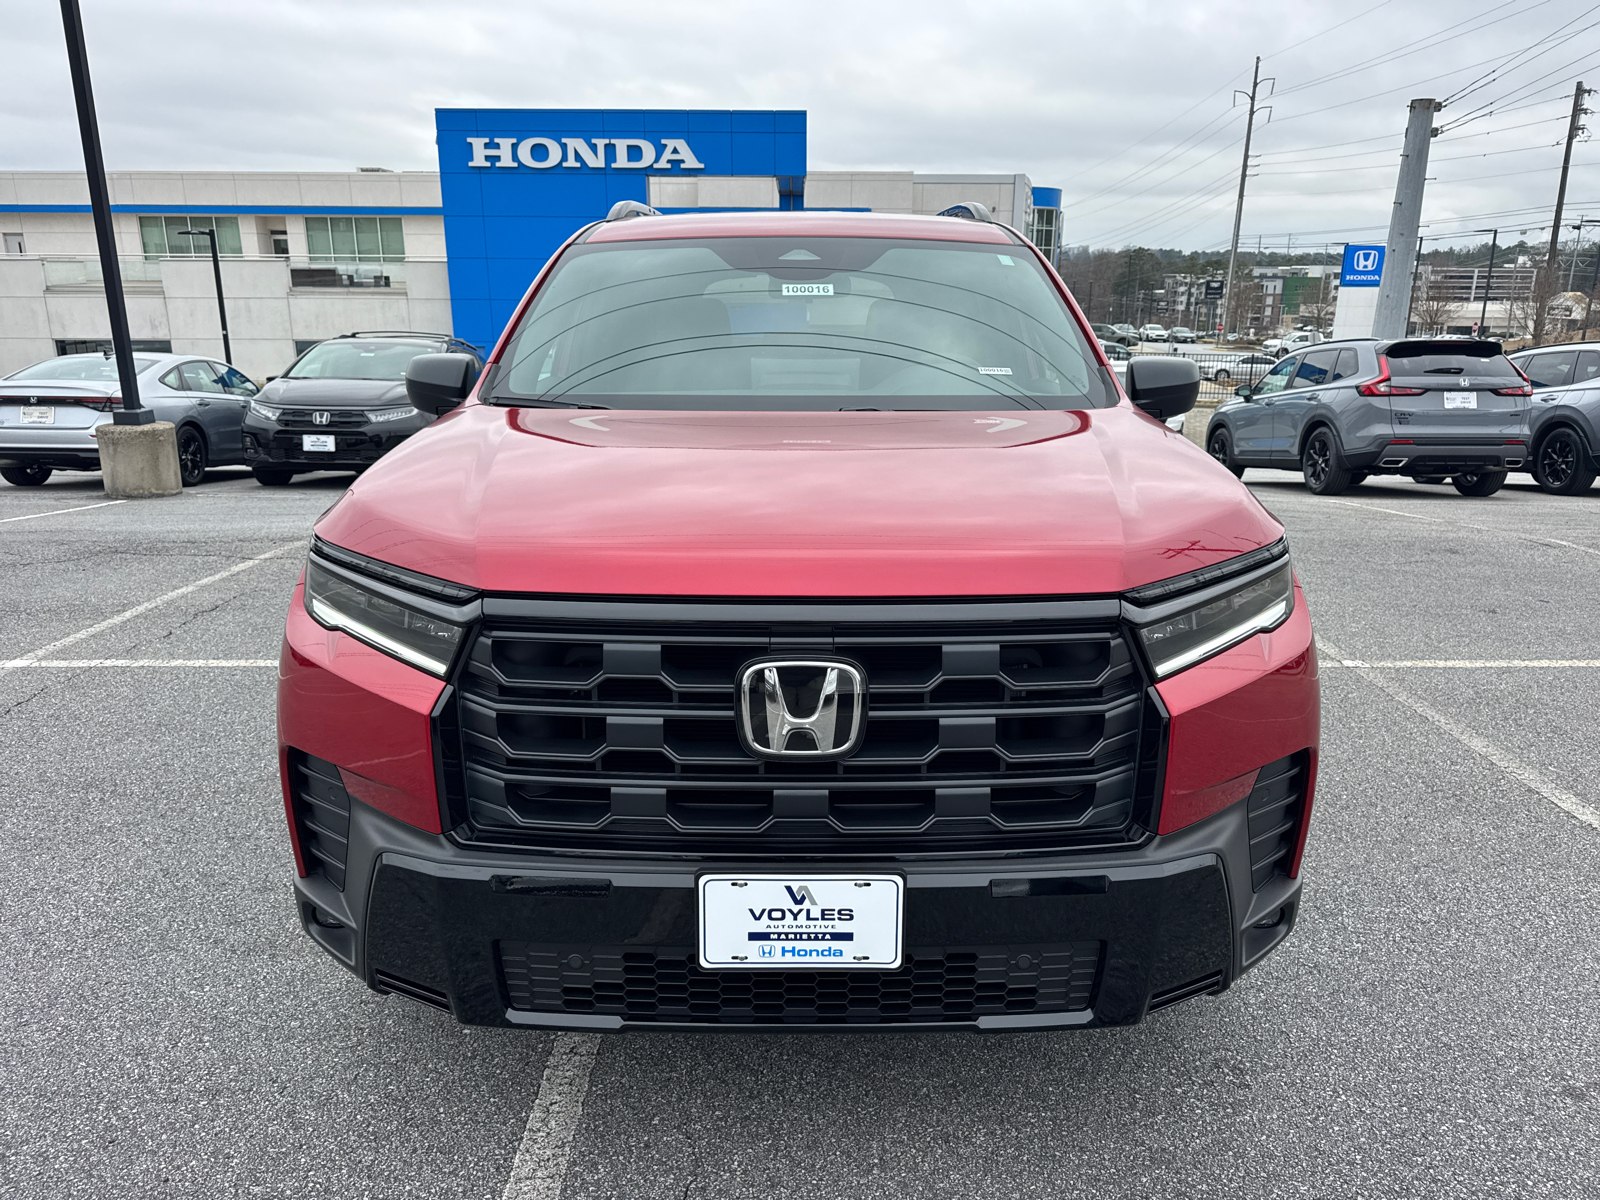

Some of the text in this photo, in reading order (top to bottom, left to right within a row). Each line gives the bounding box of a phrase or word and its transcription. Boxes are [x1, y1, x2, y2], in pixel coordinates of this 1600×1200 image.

[466, 136, 705, 170] HONDA
[748, 908, 854, 921] VOYLES
[781, 946, 843, 957] Honda
